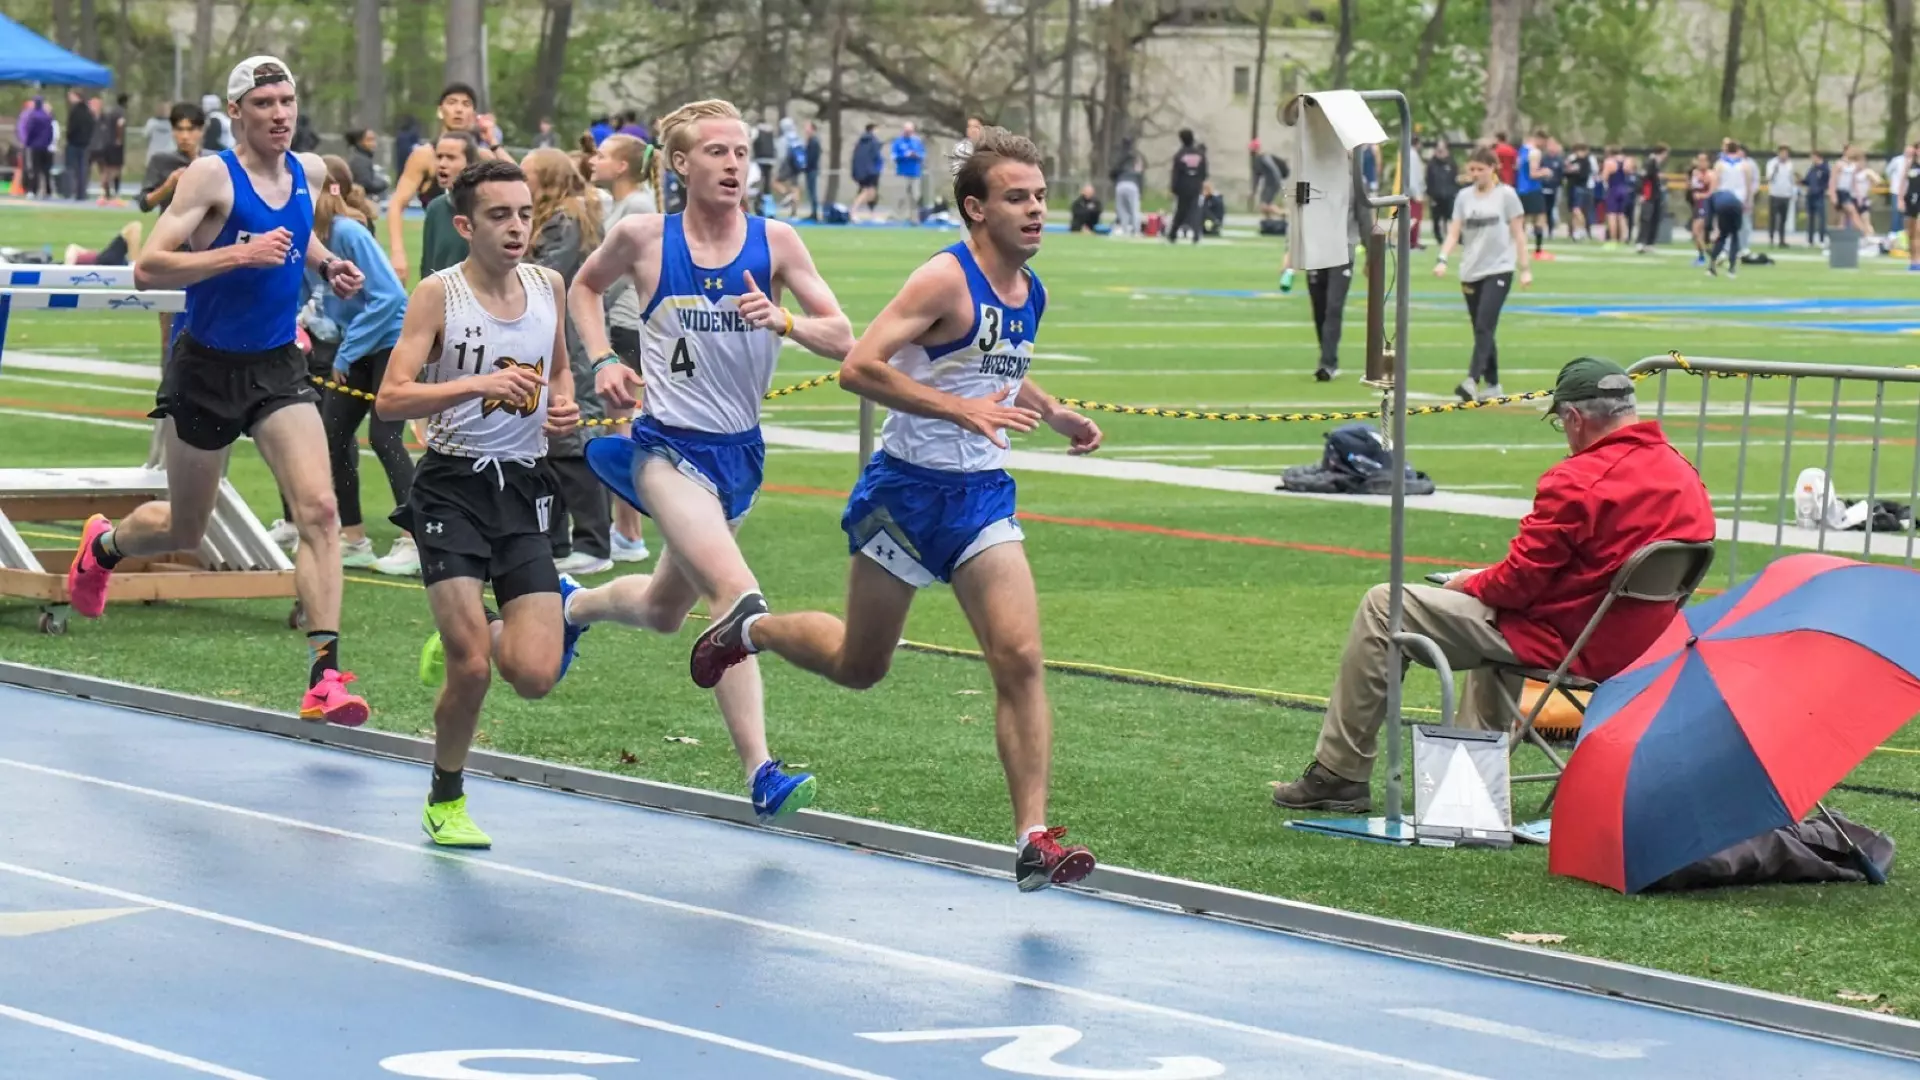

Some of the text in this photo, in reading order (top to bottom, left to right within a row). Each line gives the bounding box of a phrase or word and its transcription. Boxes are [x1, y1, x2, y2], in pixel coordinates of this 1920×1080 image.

[676, 308, 754, 332] WIDENE
[979, 307, 998, 352] 3
[454, 342, 485, 374] 11
[670, 337, 695, 378] 4
[853, 1025, 1226, 1080] 2
